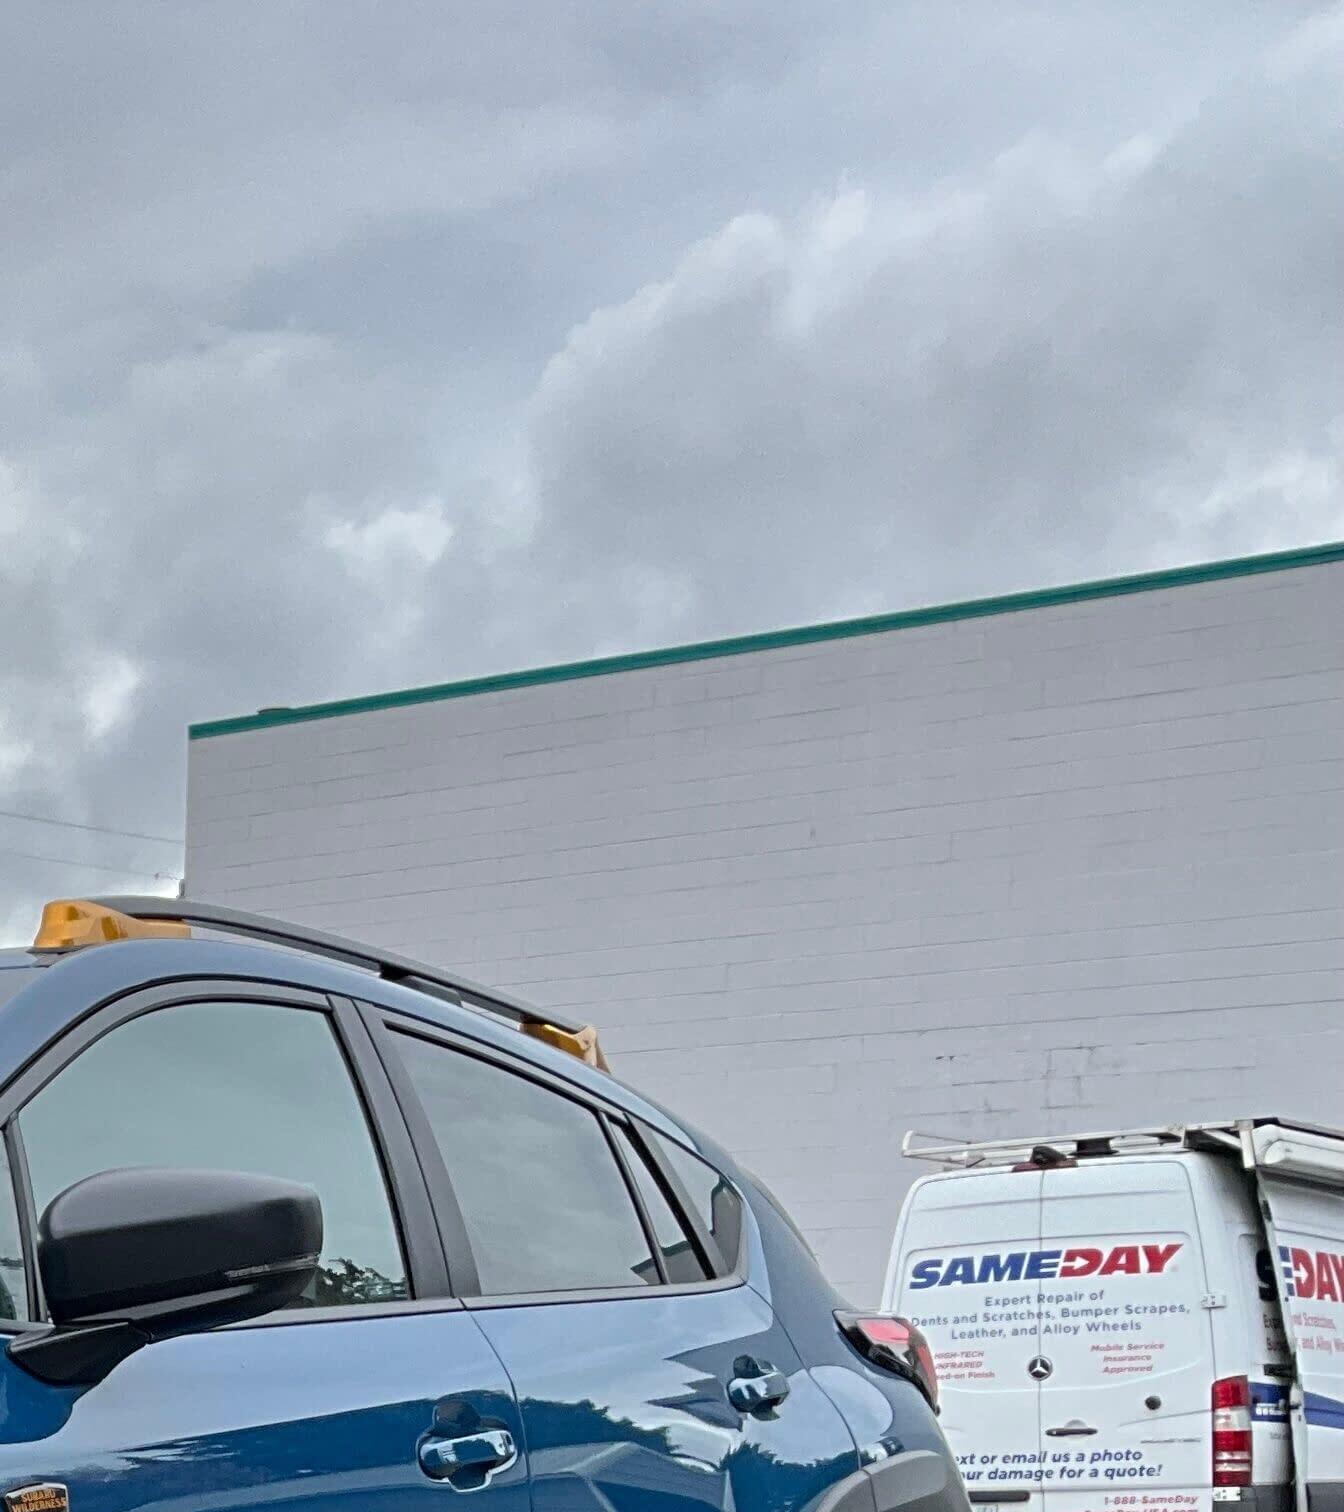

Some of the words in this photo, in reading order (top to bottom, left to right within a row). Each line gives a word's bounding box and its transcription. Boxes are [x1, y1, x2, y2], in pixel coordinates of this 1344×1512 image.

[909, 1243, 1184, 1290] SAMEDAY
[984, 1295, 1031, 1308] Expert
[1037, 1291, 1085, 1304] Repair
[1090, 1290, 1104, 1301] of
[912, 1316, 949, 1327] Dents
[953, 1313, 978, 1325] and
[1061, 1306, 1119, 1319] Bumper
[1125, 1303, 1191, 1315] Scrapes,
[952, 1327, 1006, 1340] Leather,
[1012, 1325, 1037, 1337] and
[1043, 1323, 1080, 1335] Alloy
[1086, 1319, 1142, 1332] Wheels
[1127, 1342, 1165, 1351] Service
[1103, 1354, 1152, 1363] Insurance
[936, 1372, 965, 1381] ed-on
[1103, 1365, 1154, 1374] Approved
[980, 1455, 998, 1465] or
[1002, 1450, 1048, 1464] email
[1052, 1452, 1071, 1463] us
[1075, 1452, 1086, 1462] a
[1090, 1449, 1143, 1464] photo
[988, 1468, 1054, 1481] damage
[1059, 1466, 1085, 1479] for
[1089, 1468, 1099, 1478] a
[1104, 1464, 1163, 1480] quote!
[21, 1488, 56, 1502] SUBARU
